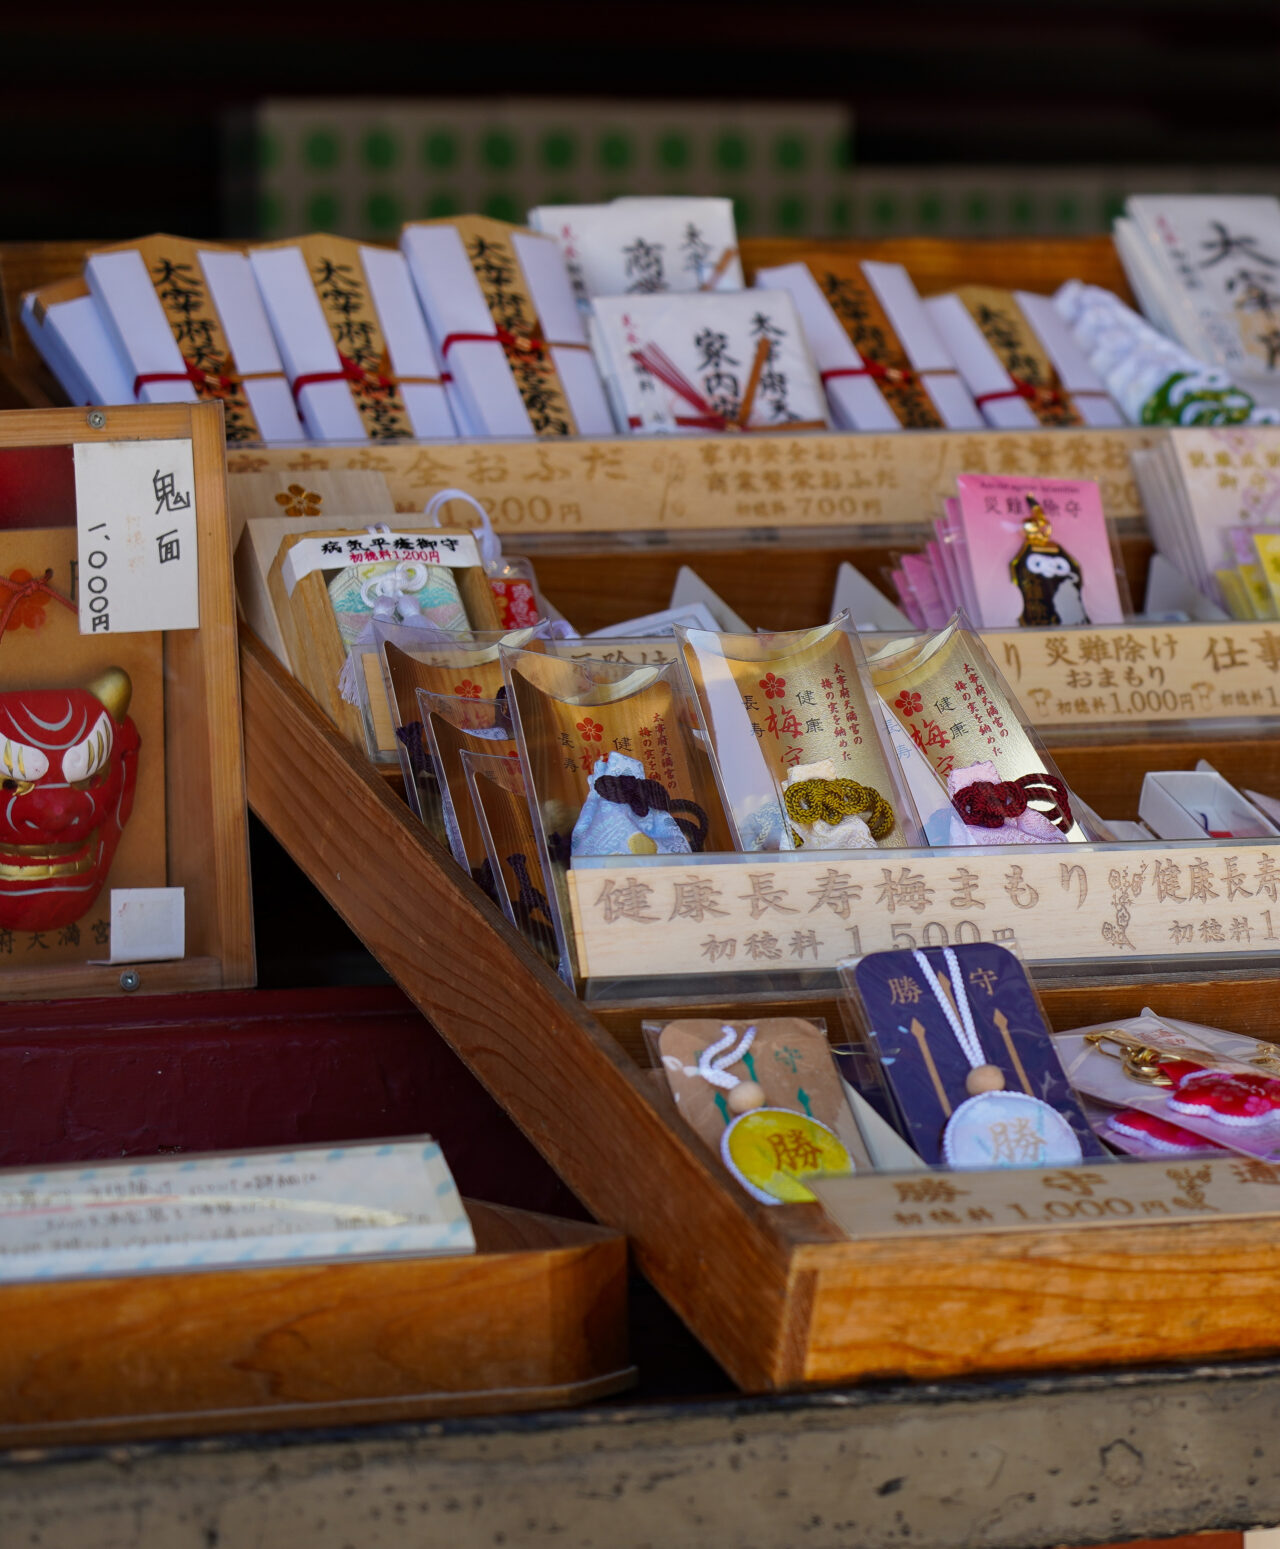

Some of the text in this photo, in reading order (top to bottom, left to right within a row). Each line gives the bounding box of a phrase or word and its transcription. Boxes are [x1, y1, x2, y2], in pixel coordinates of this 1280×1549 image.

[153, 470, 191, 564] 鬼面
[1044, 633, 1178, 667] 災難除け
[1066, 664, 1166, 689] おまもり
[795, 690, 824, 735] 健康
[933, 695, 970, 740] 健康
[594, 861, 1088, 925] 健康長寿梅まもり
[889, 967, 999, 1005] 勝 守
[767, 1128, 824, 1171] 勝
[988, 1115, 1048, 1164] 勝
